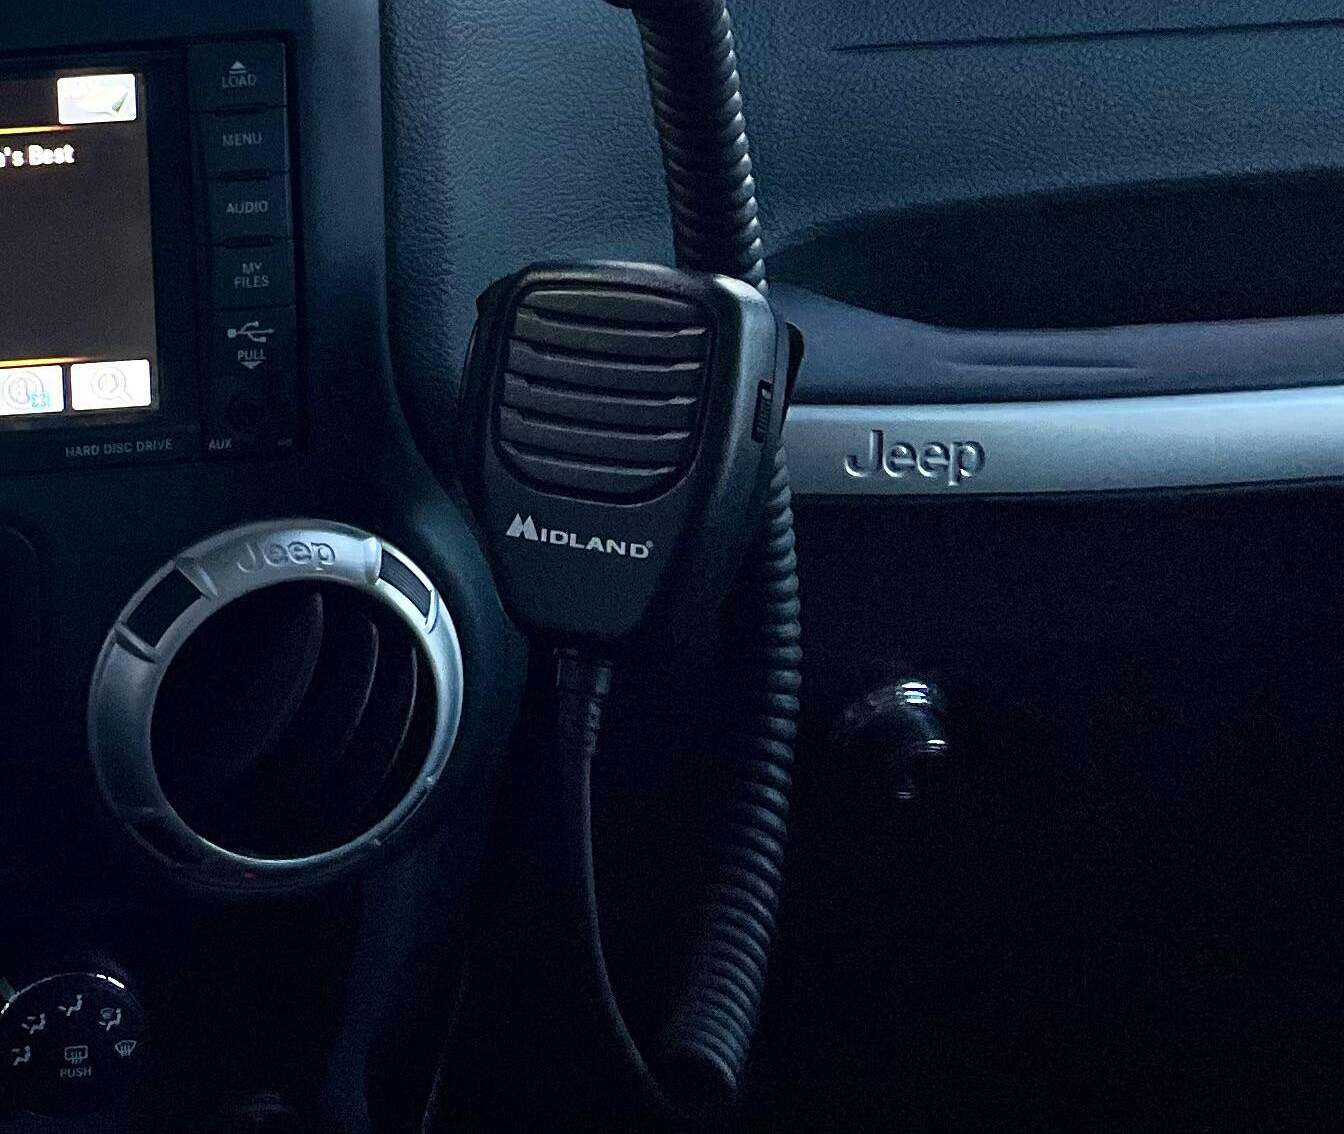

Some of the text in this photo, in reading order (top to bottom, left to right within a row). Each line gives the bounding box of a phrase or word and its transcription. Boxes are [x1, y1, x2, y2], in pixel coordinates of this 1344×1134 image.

[221, 74, 257, 89] LOAD
[222, 132, 263, 147] MENU
[28, 144, 75, 166] Best
[225, 199, 269, 214] AUDIO
[242, 262, 263, 275] MY
[233, 275, 271, 289] FILES
[237, 348, 267, 362] PULL
[64, 438, 174, 458] HARD DISC DRIVE
[208, 438, 233, 451] AUX
[844, 428, 986, 487] Jeep
[505, 513, 650, 559] MIDLAND
[235, 541, 336, 574] Jeep
[59, 1065, 93, 1079] PUSH
